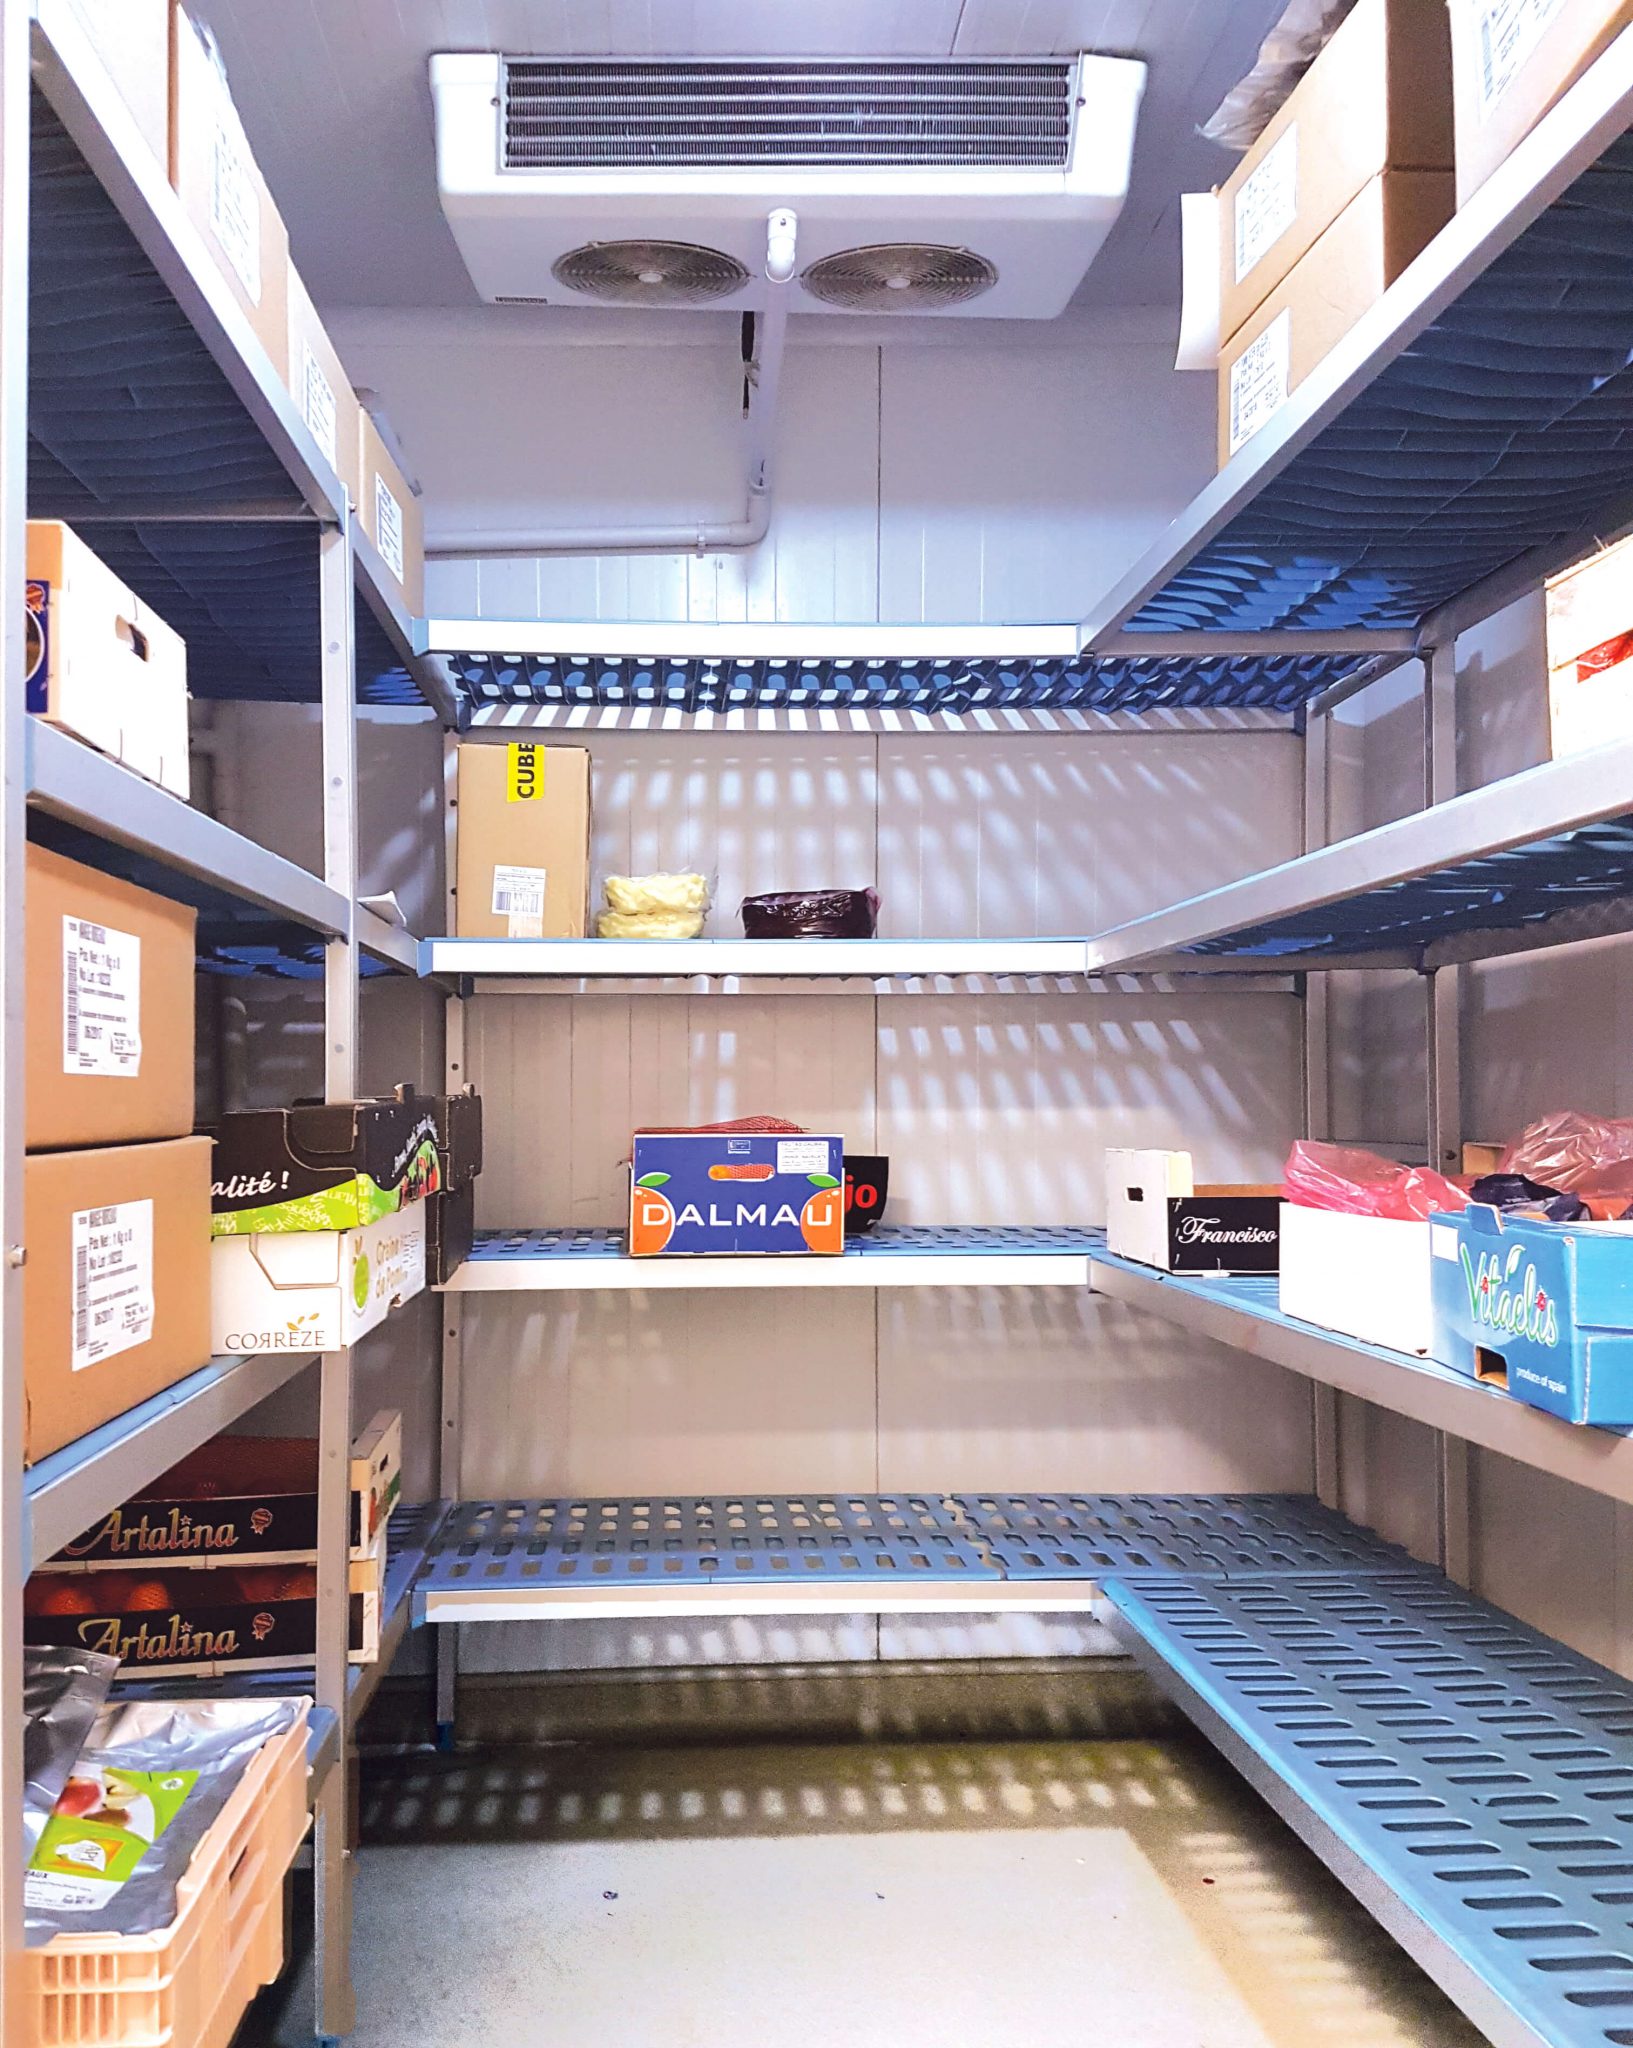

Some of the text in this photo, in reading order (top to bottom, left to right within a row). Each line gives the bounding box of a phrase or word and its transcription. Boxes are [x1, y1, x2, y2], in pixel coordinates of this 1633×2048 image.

[516, 743, 535, 799] CUBE
[642, 1203, 833, 1227] DALMAU
[1178, 1216, 1278, 1244] Francisco
[64, 1507, 240, 1556] Artalina
[78, 1613, 241, 1660] Artalina
